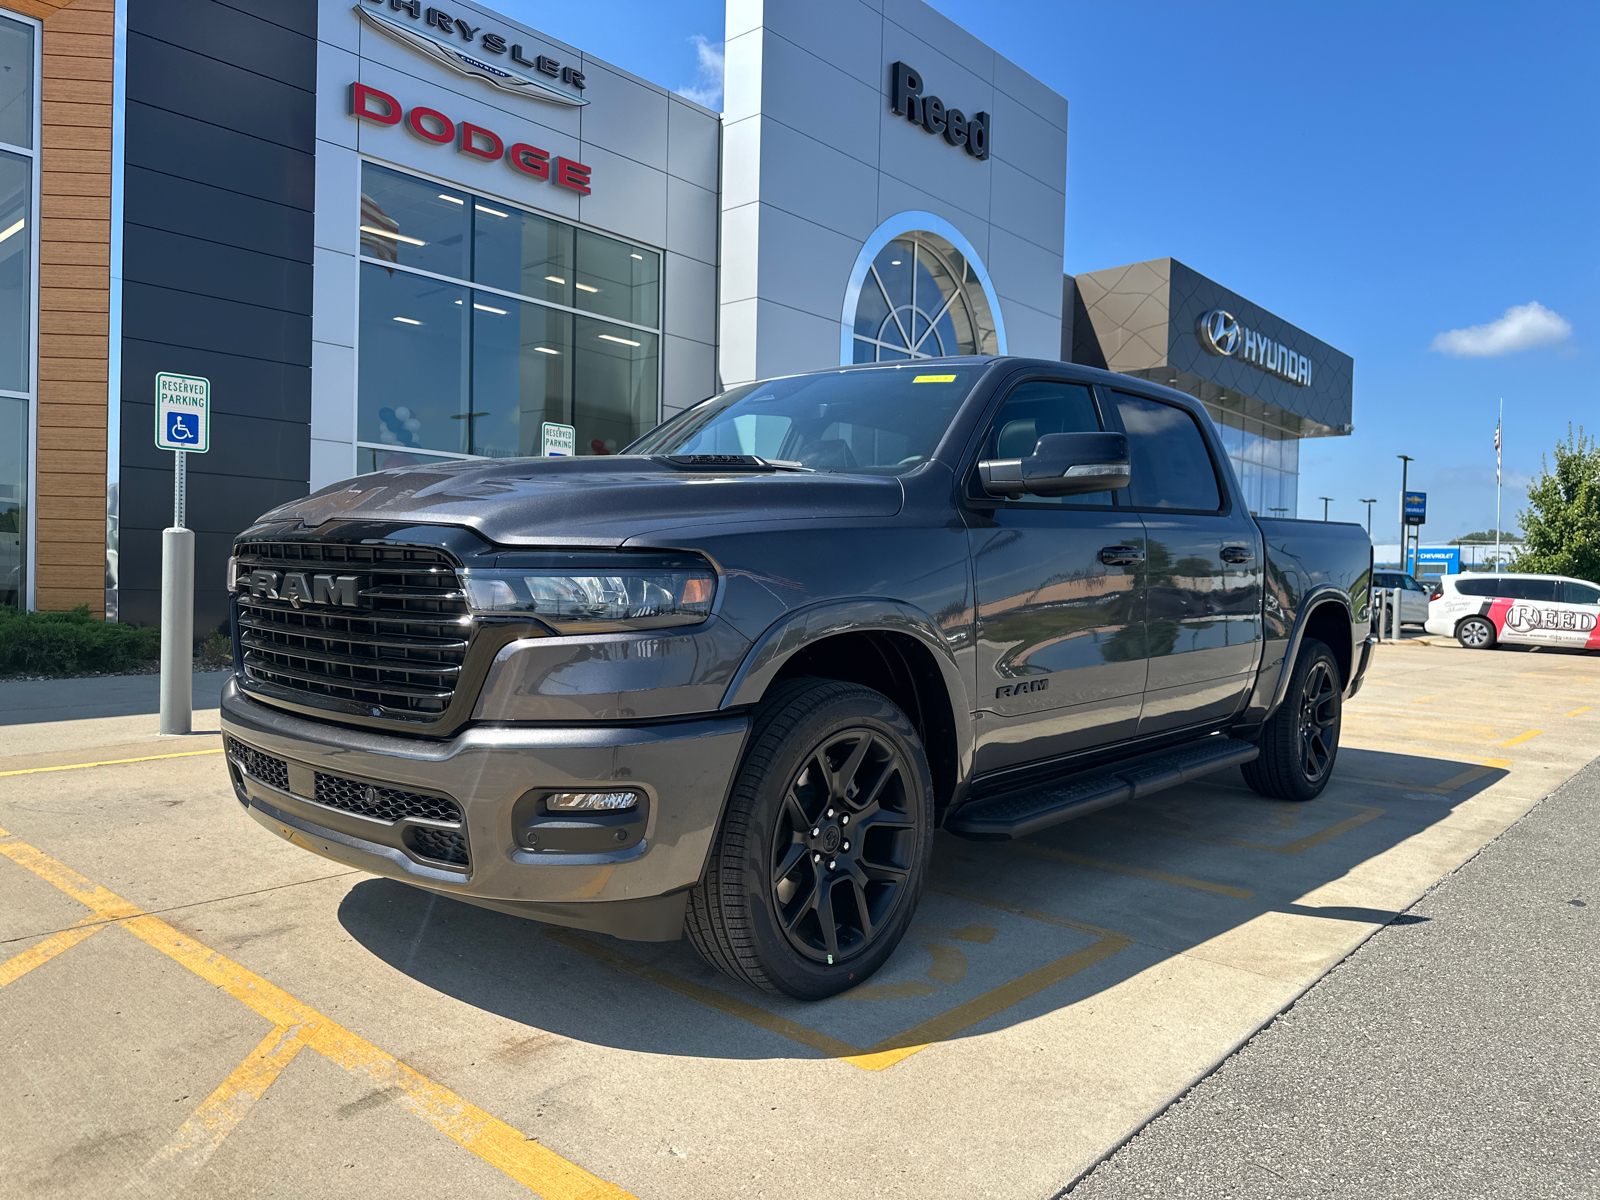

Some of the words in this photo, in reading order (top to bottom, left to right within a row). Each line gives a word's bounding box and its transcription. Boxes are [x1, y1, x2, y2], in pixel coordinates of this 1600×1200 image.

[371, 0, 586, 89] HRYSLER
[460, 56, 506, 77] CHRYSLER
[891, 61, 991, 161] Reed
[349, 81, 592, 195] DODGE
[1239, 327, 1312, 387] HYUNDAI
[162, 381, 204, 394] RESERVED
[162, 393, 204, 407] PARKING
[546, 428, 572, 439] RESERVED
[546, 438, 572, 449] PARKING
[252, 569, 362, 608] RAM
[1509, 605, 1595, 631] REED
[996, 678, 1049, 699] RAM
